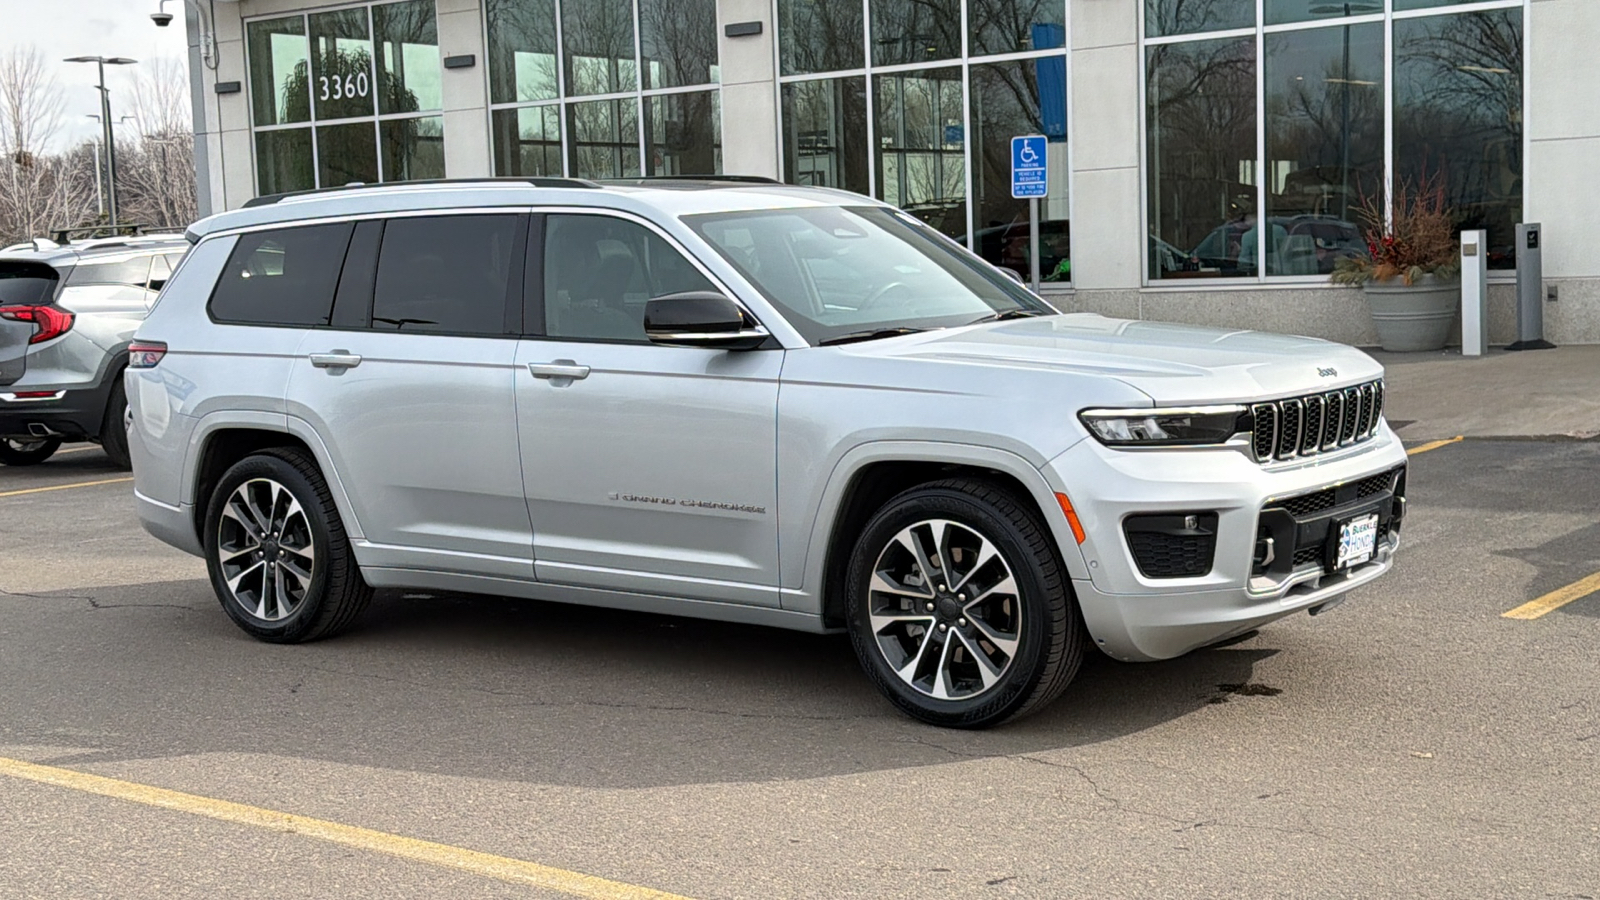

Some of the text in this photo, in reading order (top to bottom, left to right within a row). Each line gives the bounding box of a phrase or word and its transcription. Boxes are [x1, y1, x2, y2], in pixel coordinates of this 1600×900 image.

[319, 72, 368, 101] 3360
[622, 493, 766, 514] GRAND CHEROKEE
